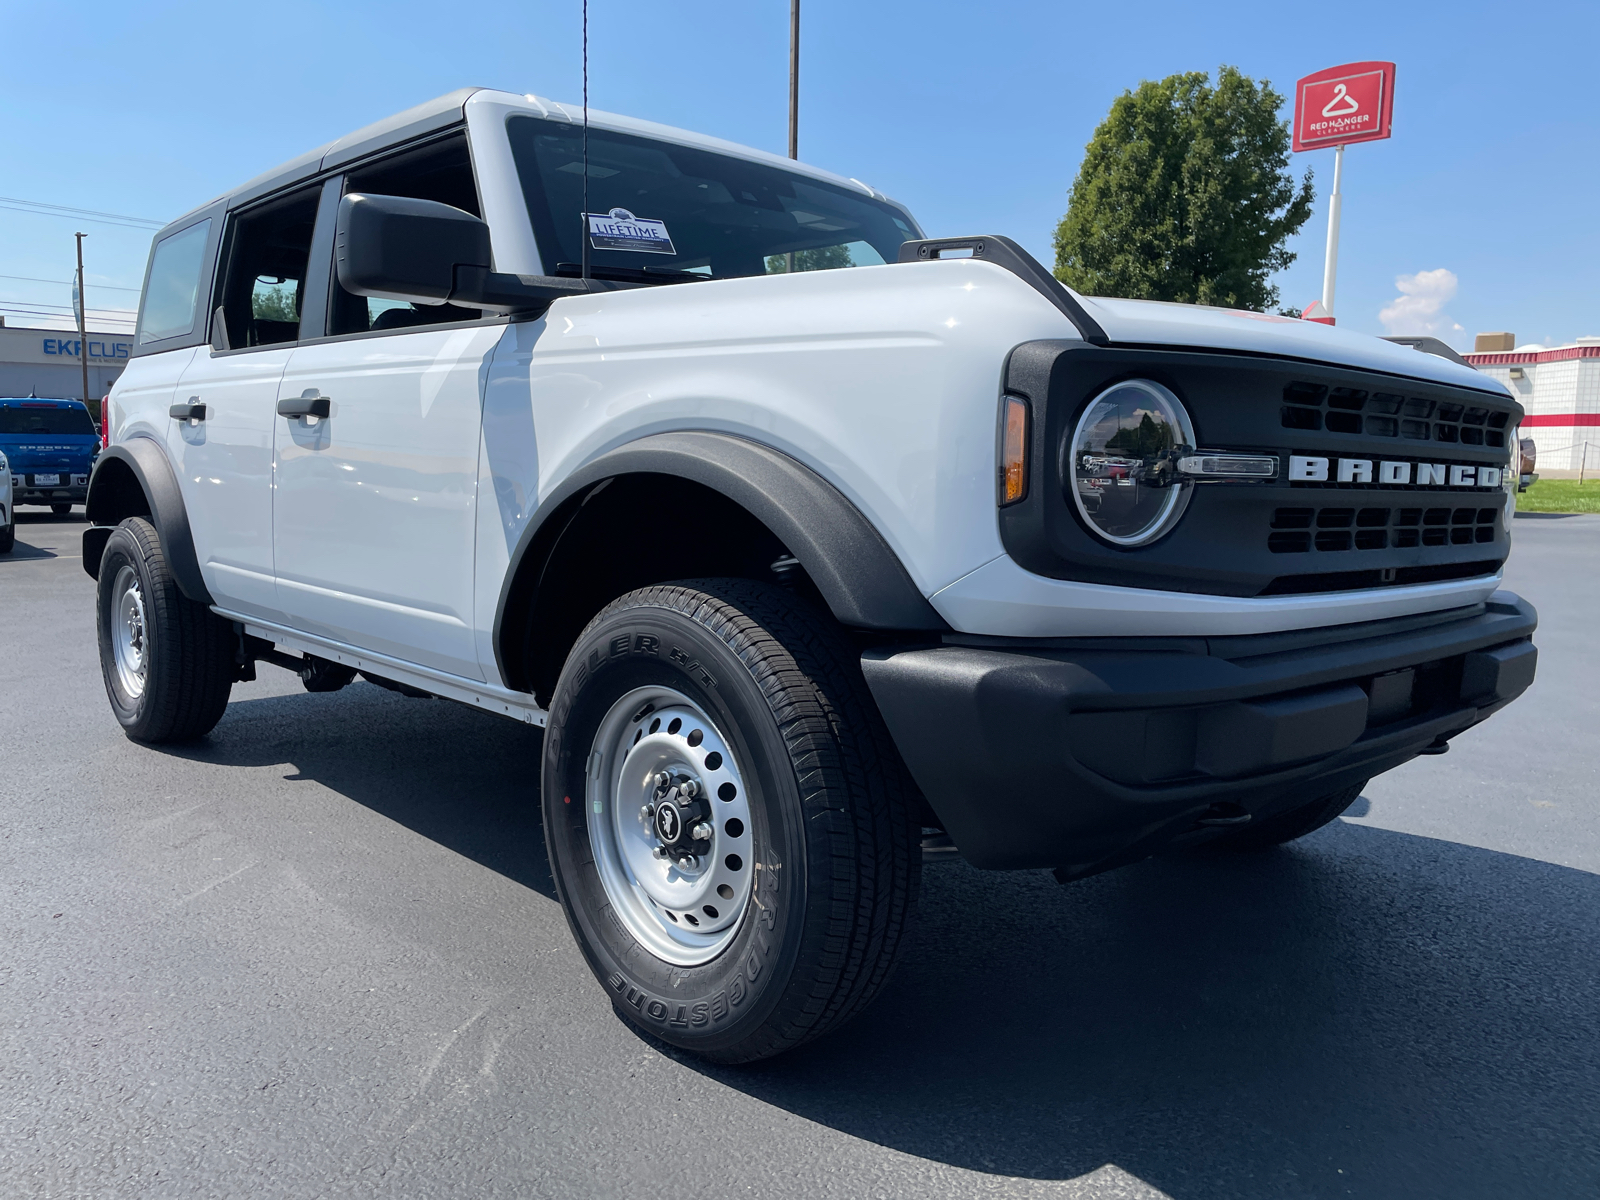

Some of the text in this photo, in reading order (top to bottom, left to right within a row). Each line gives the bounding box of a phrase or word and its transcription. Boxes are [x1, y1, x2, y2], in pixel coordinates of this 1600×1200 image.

[1310, 114, 1370, 131] RED HANGER
[1317, 124, 1360, 135] CLEANERS
[596, 224, 659, 238] LIFETIME
[1288, 454, 1500, 488] BRONCO
[608, 848, 782, 1029] BRIDGESTONE
